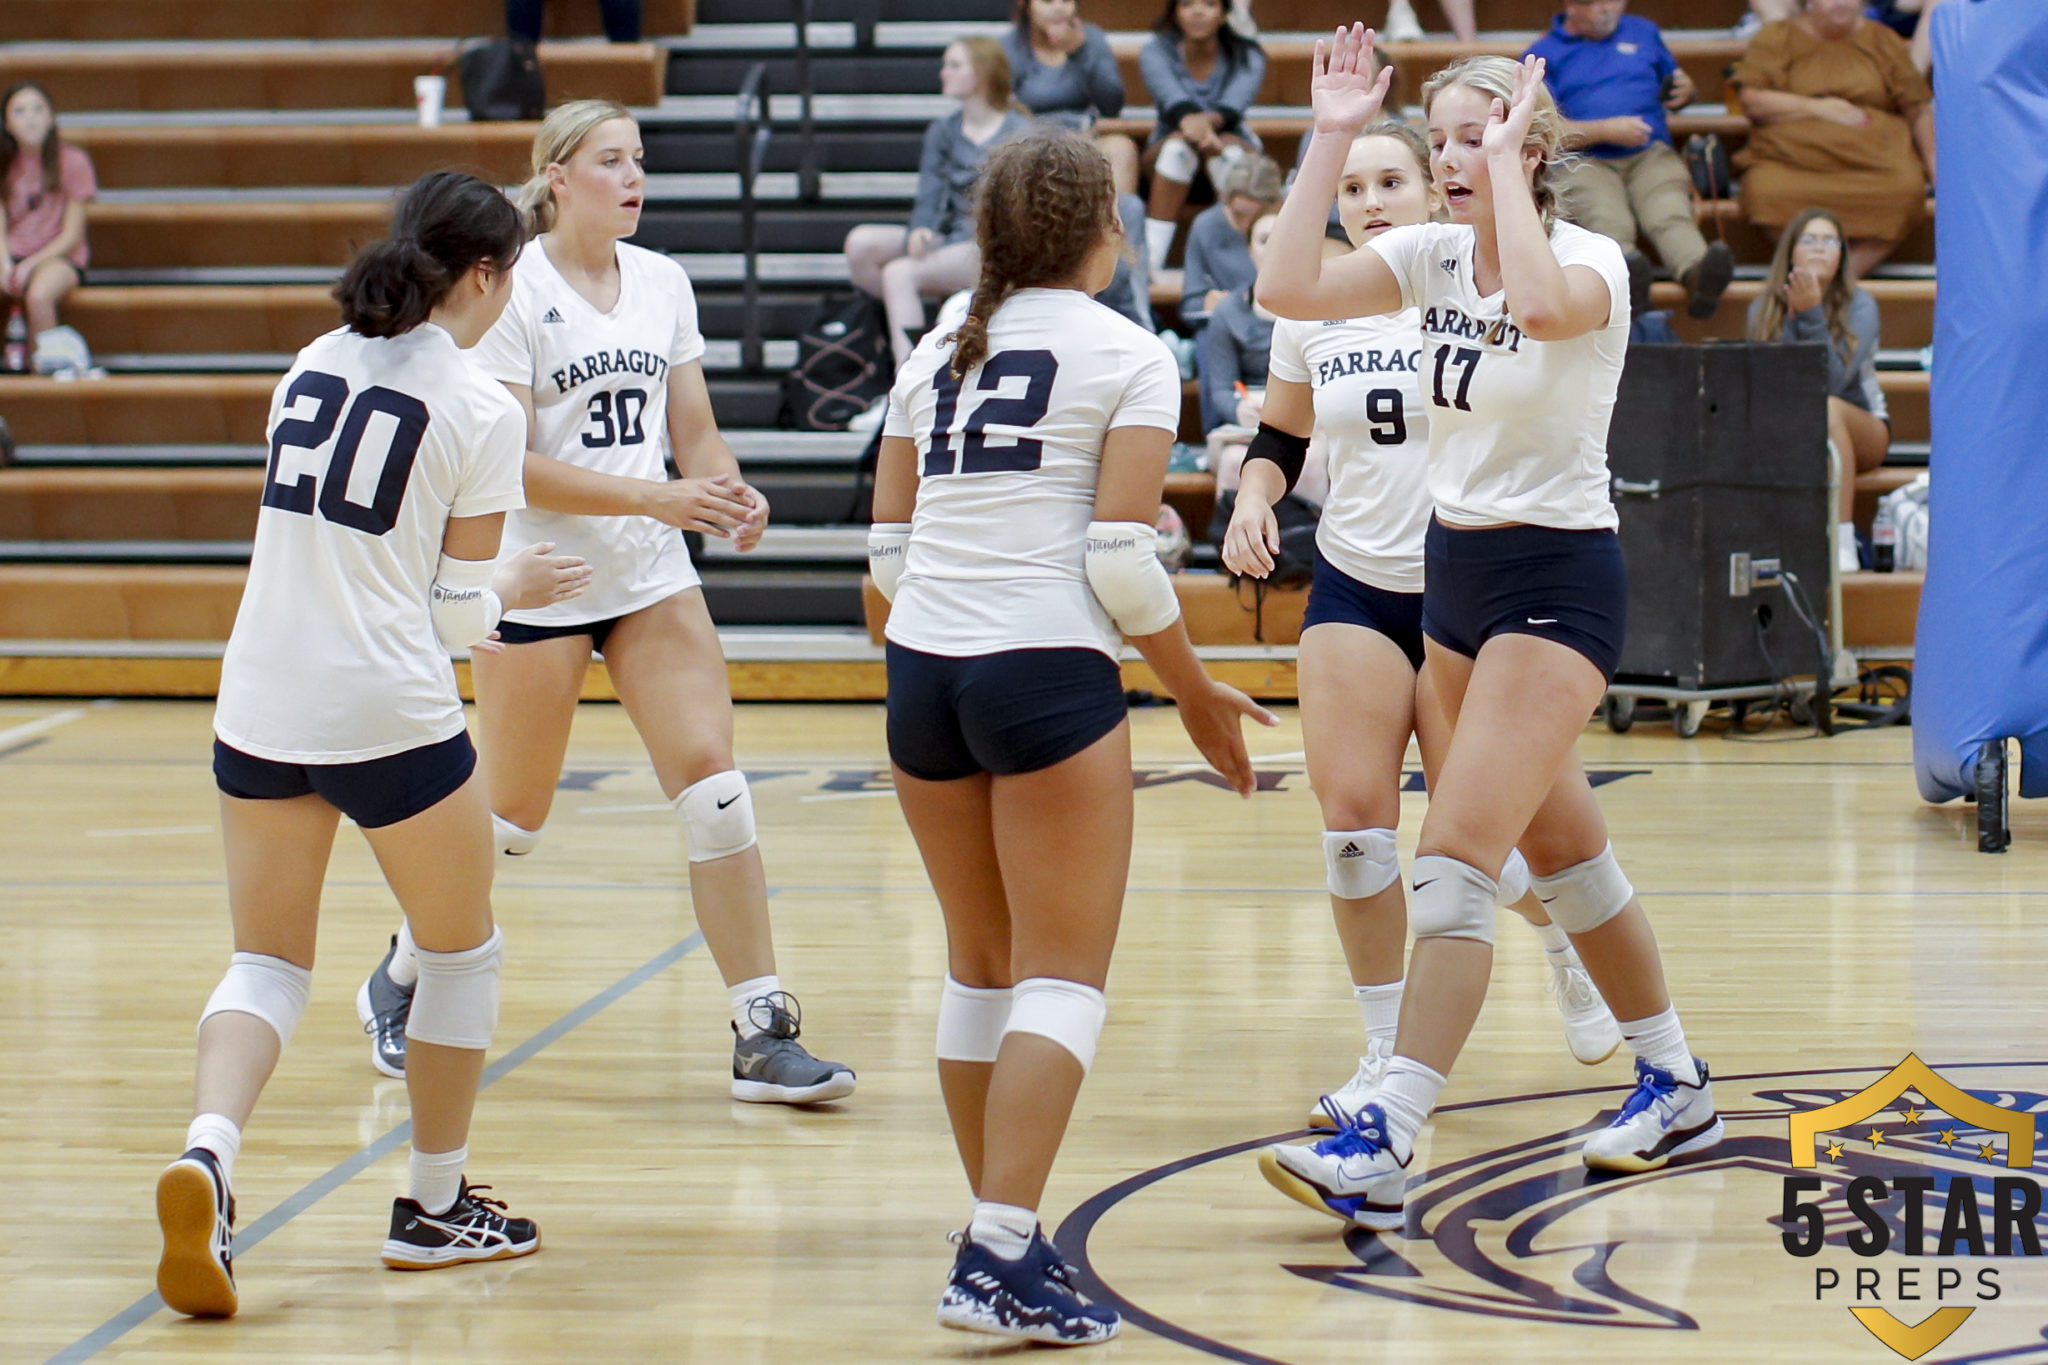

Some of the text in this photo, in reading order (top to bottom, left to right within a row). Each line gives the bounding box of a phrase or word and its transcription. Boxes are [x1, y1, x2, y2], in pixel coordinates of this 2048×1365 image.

[551, 348, 668, 394] FARRAGUT
[1431, 344, 1484, 412] 17
[581, 388, 648, 448] 30
[923, 349, 1059, 477] 12
[1366, 388, 1407, 445] 9
[262, 370, 431, 536] 20
